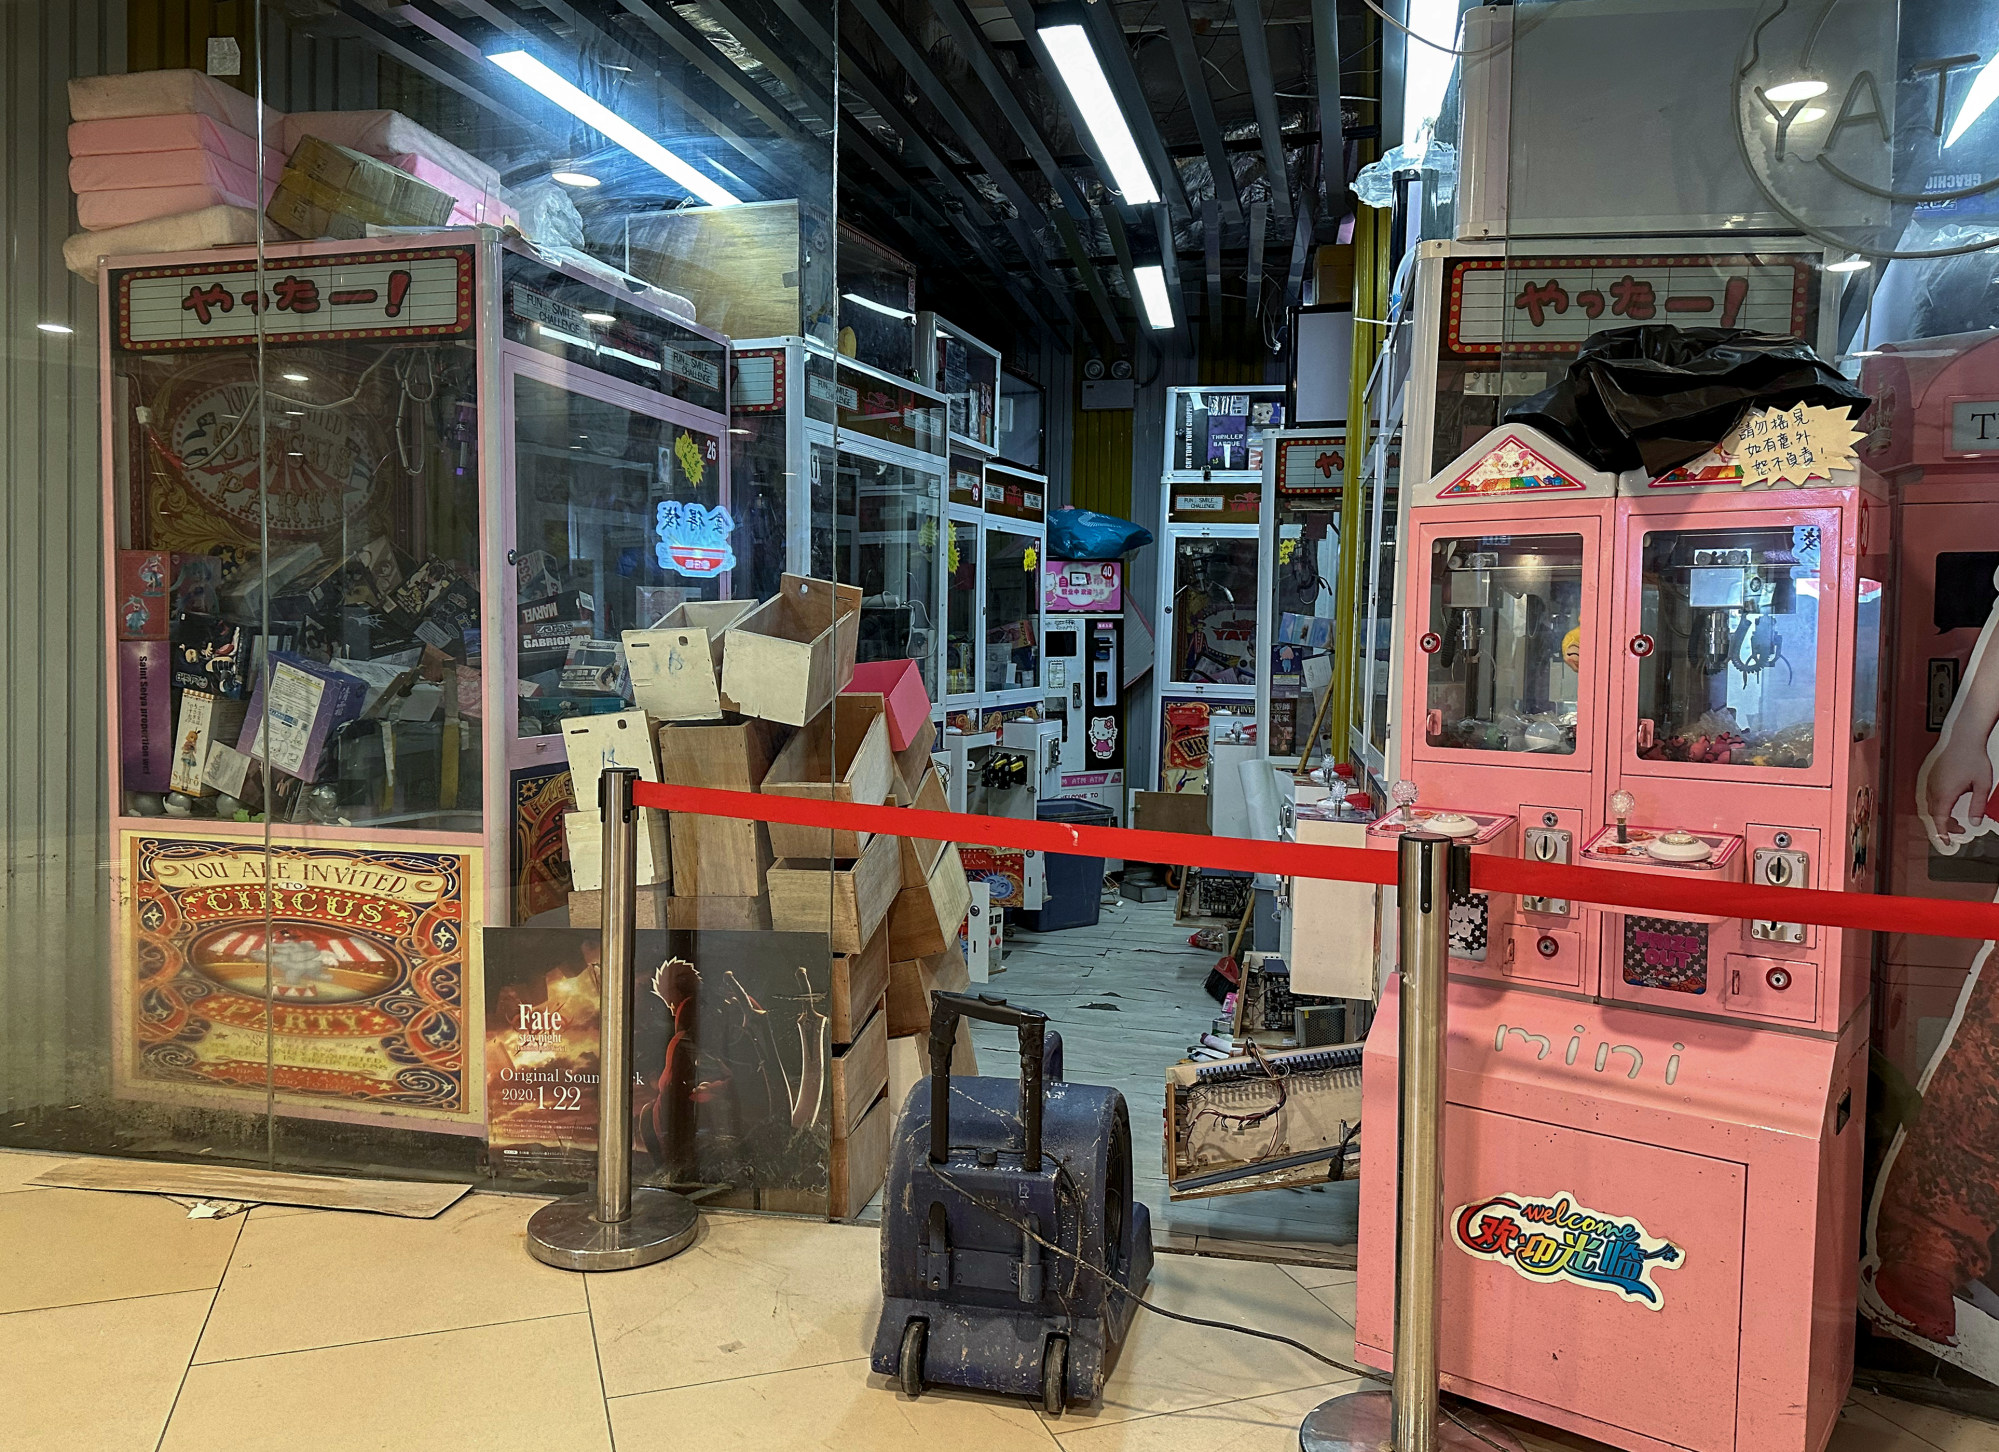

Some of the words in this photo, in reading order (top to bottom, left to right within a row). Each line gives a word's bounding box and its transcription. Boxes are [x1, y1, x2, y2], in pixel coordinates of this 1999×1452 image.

[706, 439, 717, 461] 26
[1102, 565, 1112, 577] 40
[522, 602, 559, 624] MARVEL
[182, 861, 229, 880] YOU
[303, 863, 408, 894] INVITED
[282, 881, 303, 890] TO
[206, 890, 384, 924] CIRCUS
[1634, 929, 1701, 955] PRIZE
[1643, 949, 1692, 970] OUT
[221, 1003, 363, 1031] PARTY
[518, 1003, 562, 1031] Fate
[538, 1030, 562, 1045] night
[1494, 1022, 1687, 1086] mini
[500, 1067, 560, 1085] Original
[564, 1069, 645, 1086] Sounk
[1521, 1198, 1641, 1242] welcome
[1458, 1208, 1652, 1290] 欢迎光临
